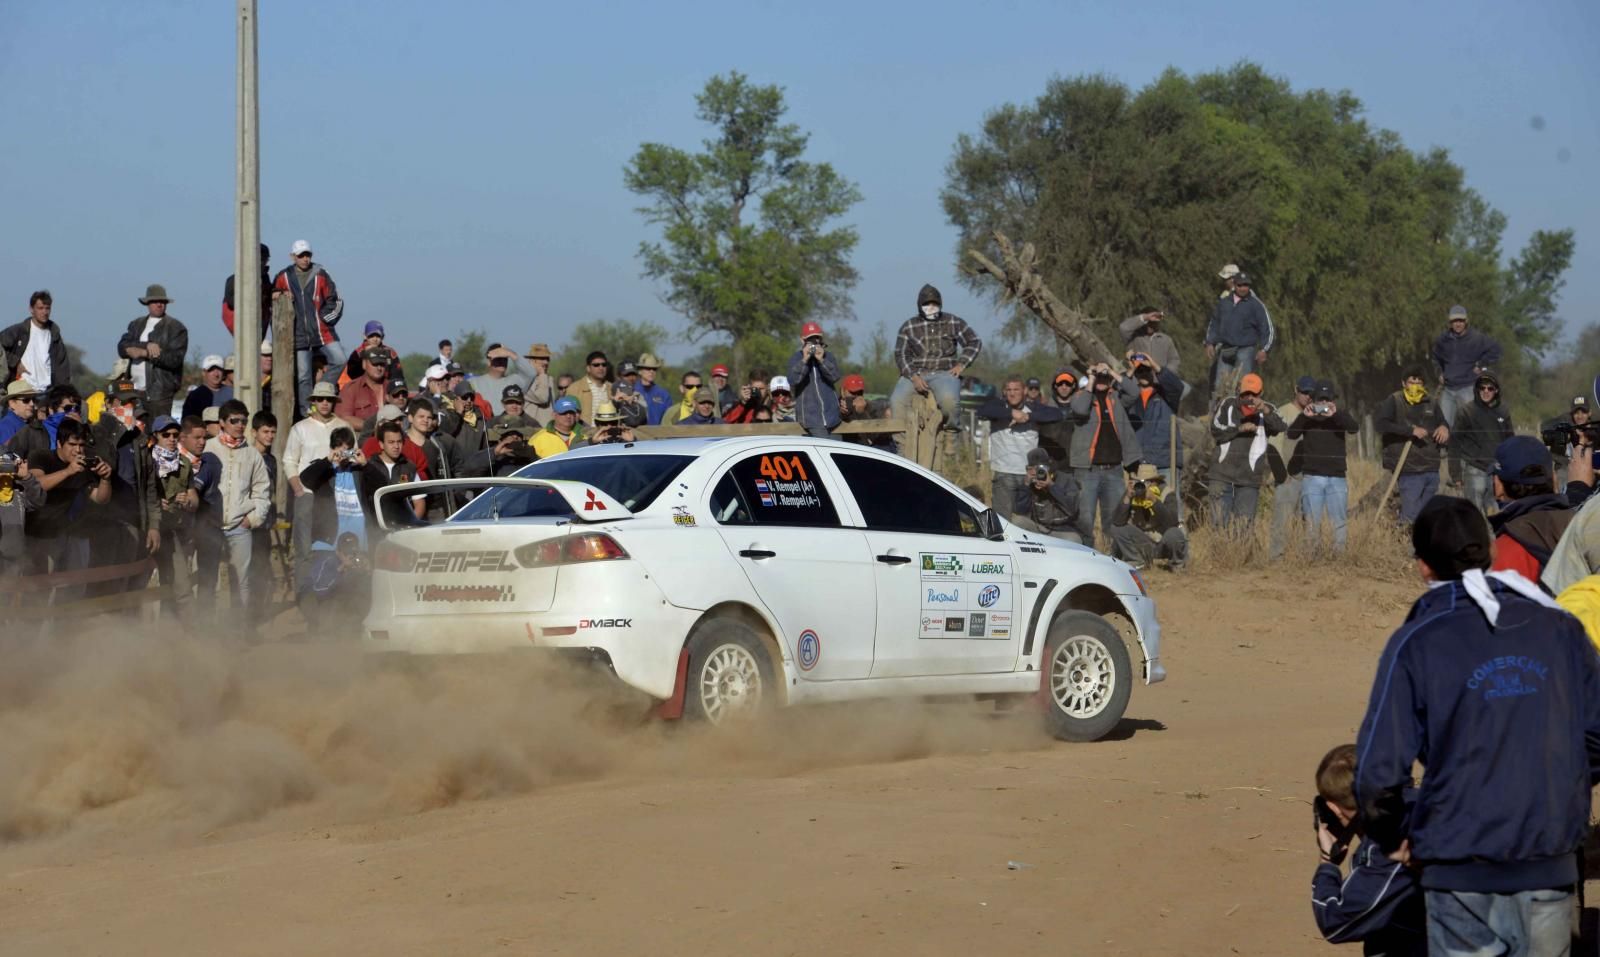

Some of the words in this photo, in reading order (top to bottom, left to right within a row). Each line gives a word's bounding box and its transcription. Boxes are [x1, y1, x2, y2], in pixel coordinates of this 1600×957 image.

[760, 455, 808, 480] 401
[774, 481, 801, 494] Rempel
[780, 494, 806, 508] Rempel
[415, 550, 518, 573] REMPEL
[971, 563, 1005, 574] LUBRAX
[927, 588, 959, 603] Personal
